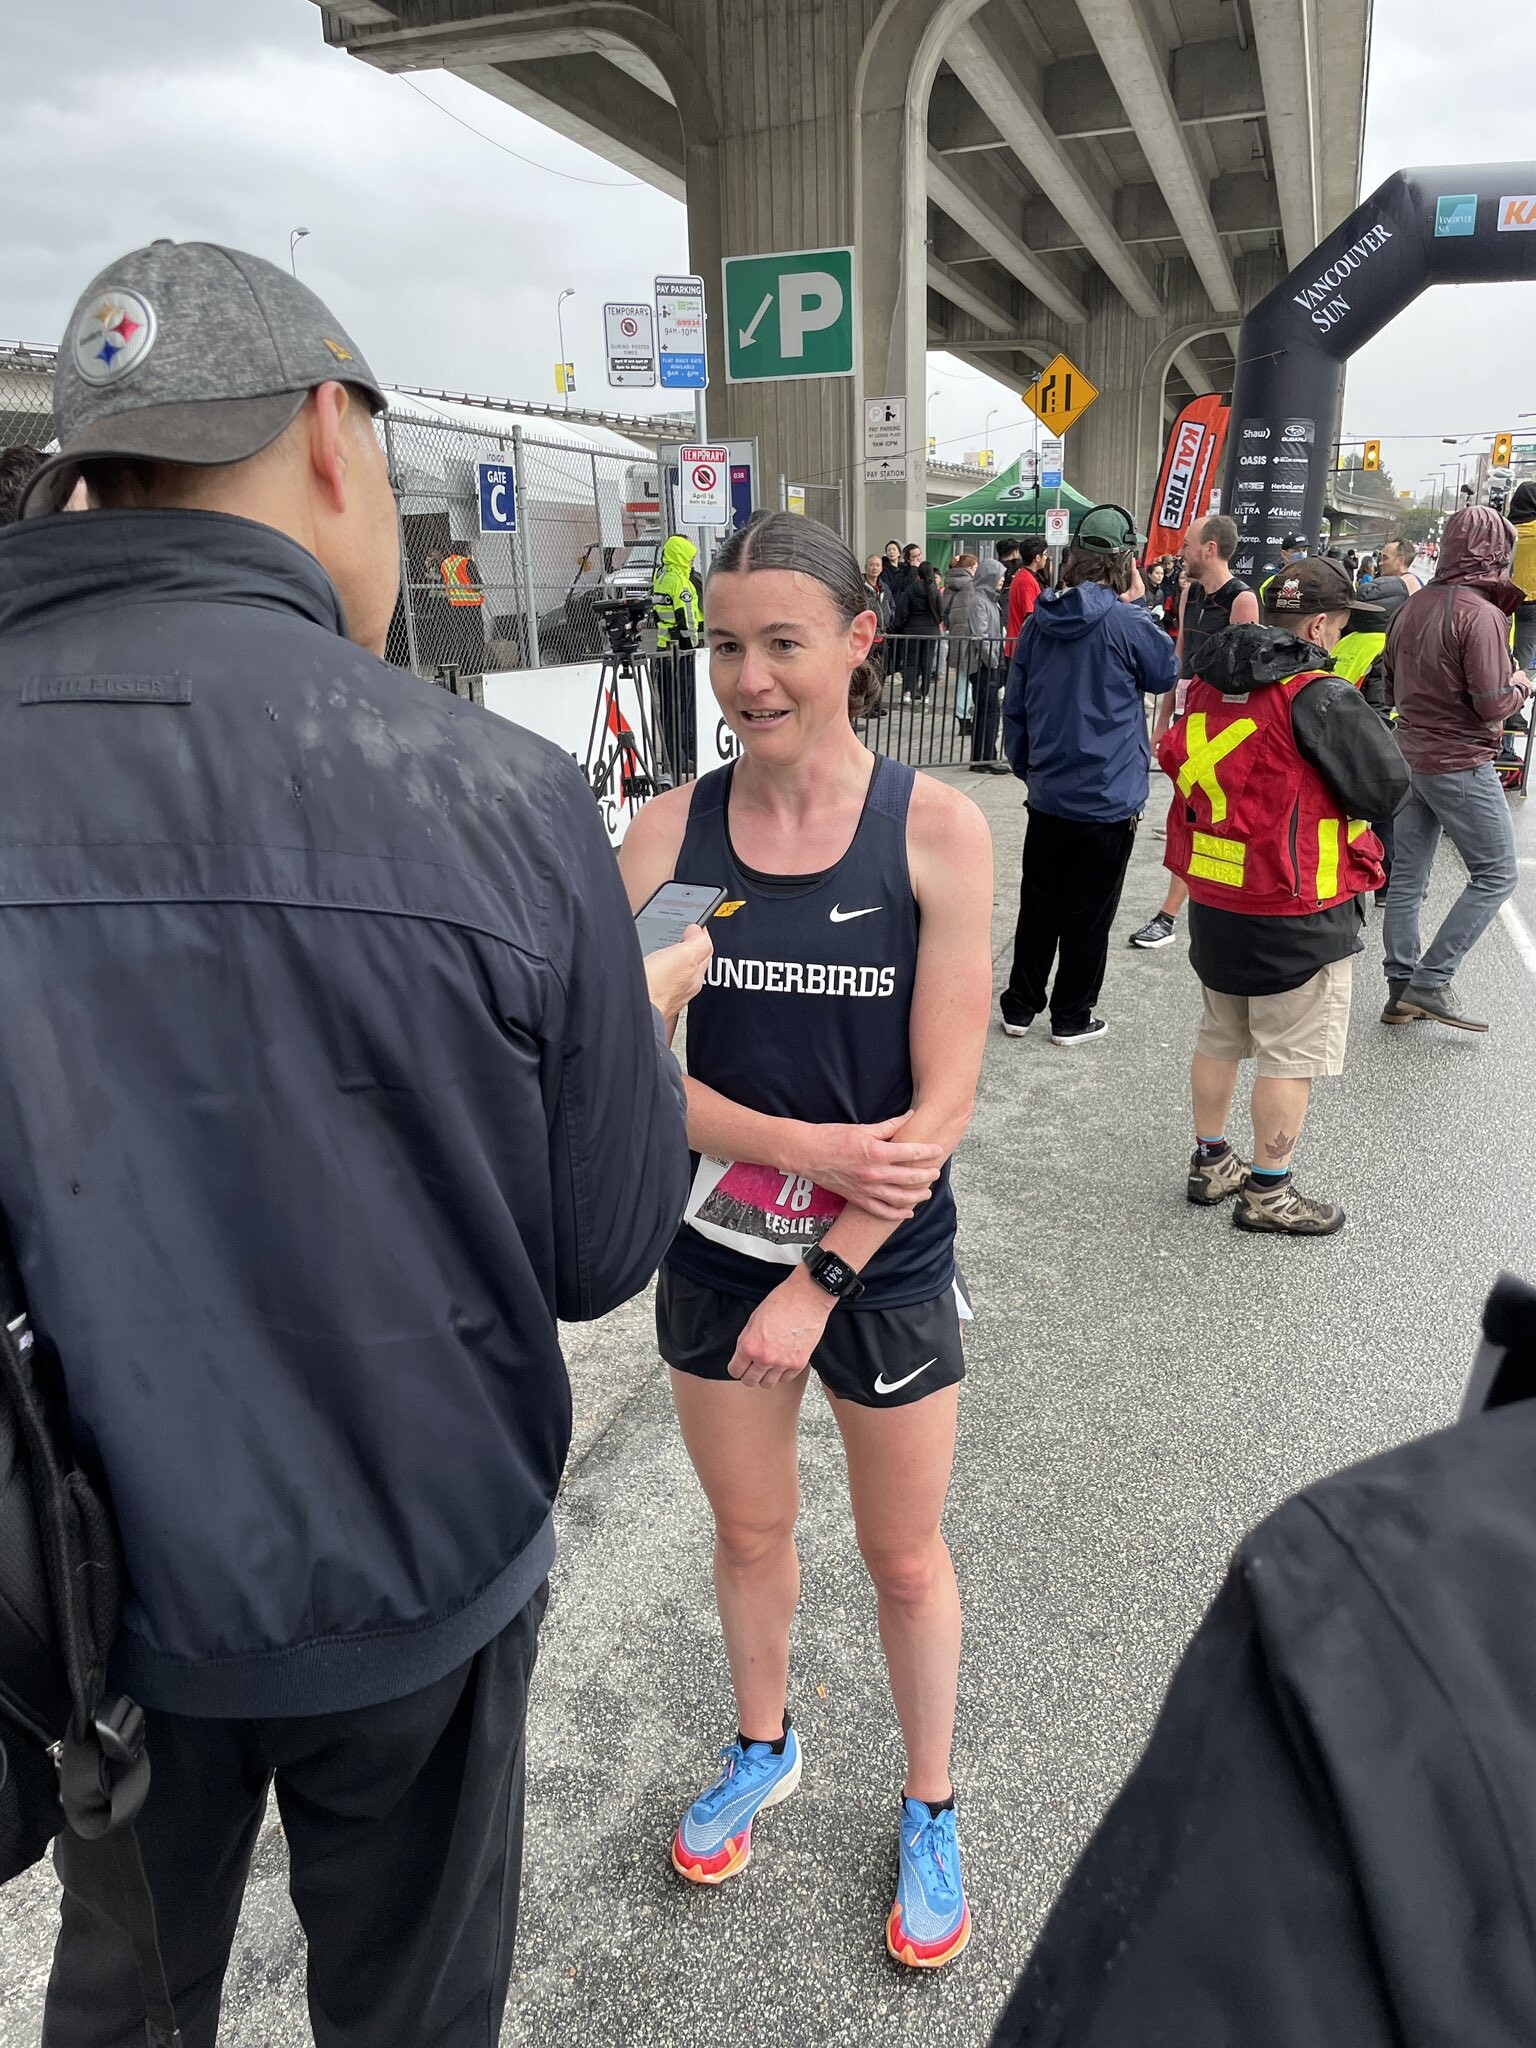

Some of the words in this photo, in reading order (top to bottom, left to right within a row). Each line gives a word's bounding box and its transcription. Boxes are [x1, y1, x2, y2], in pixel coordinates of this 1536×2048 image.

[1293, 224, 1393, 310] VANCOUVER
[656, 285, 669, 294] PAY
[671, 285, 702, 295] PARKING
[607, 306, 649, 316] TEMPORARY
[778, 271, 843, 358] P
[1311, 294, 1351, 334] SUN
[684, 450, 725, 461] TEMPORARY
[1174, 427, 1200, 470] KAL
[1240, 456, 1267, 465] OASIS
[487, 470, 507, 484] GATE
[490, 484, 507, 523] C
[1164, 473, 1189, 525] TIRE
[1234, 507, 1261, 515] ULTRA
[1279, 507, 1302, 517] kintec
[46, 678, 164, 694] HILFIGER
[701, 957, 896, 998] UNDERBIRDS
[775, 1170, 814, 1212] 78
[765, 1212, 815, 1235] LESLIE
